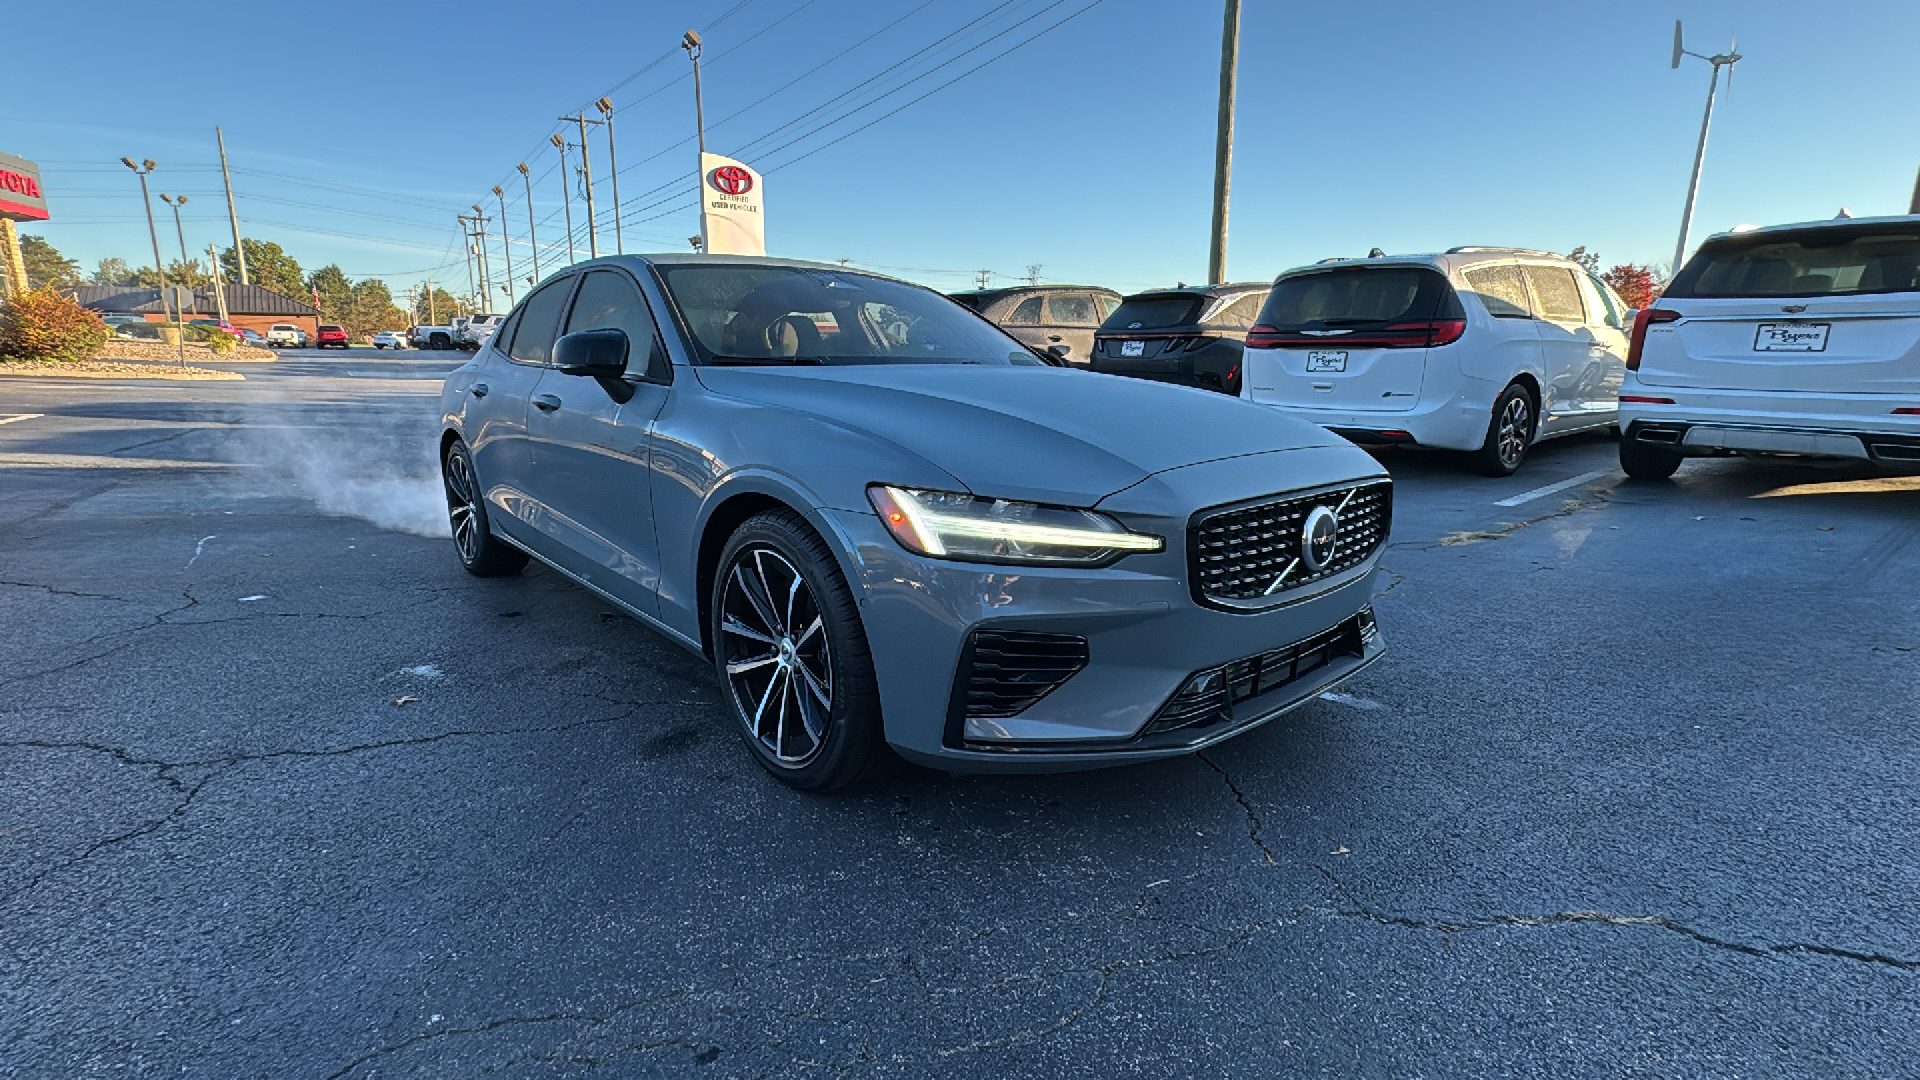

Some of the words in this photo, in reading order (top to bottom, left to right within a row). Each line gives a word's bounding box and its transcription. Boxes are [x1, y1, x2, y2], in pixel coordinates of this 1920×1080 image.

[720, 193, 749, 203] CERTIFIED
[712, 201, 728, 209] USED
[730, 203, 757, 212] VEHICLES
